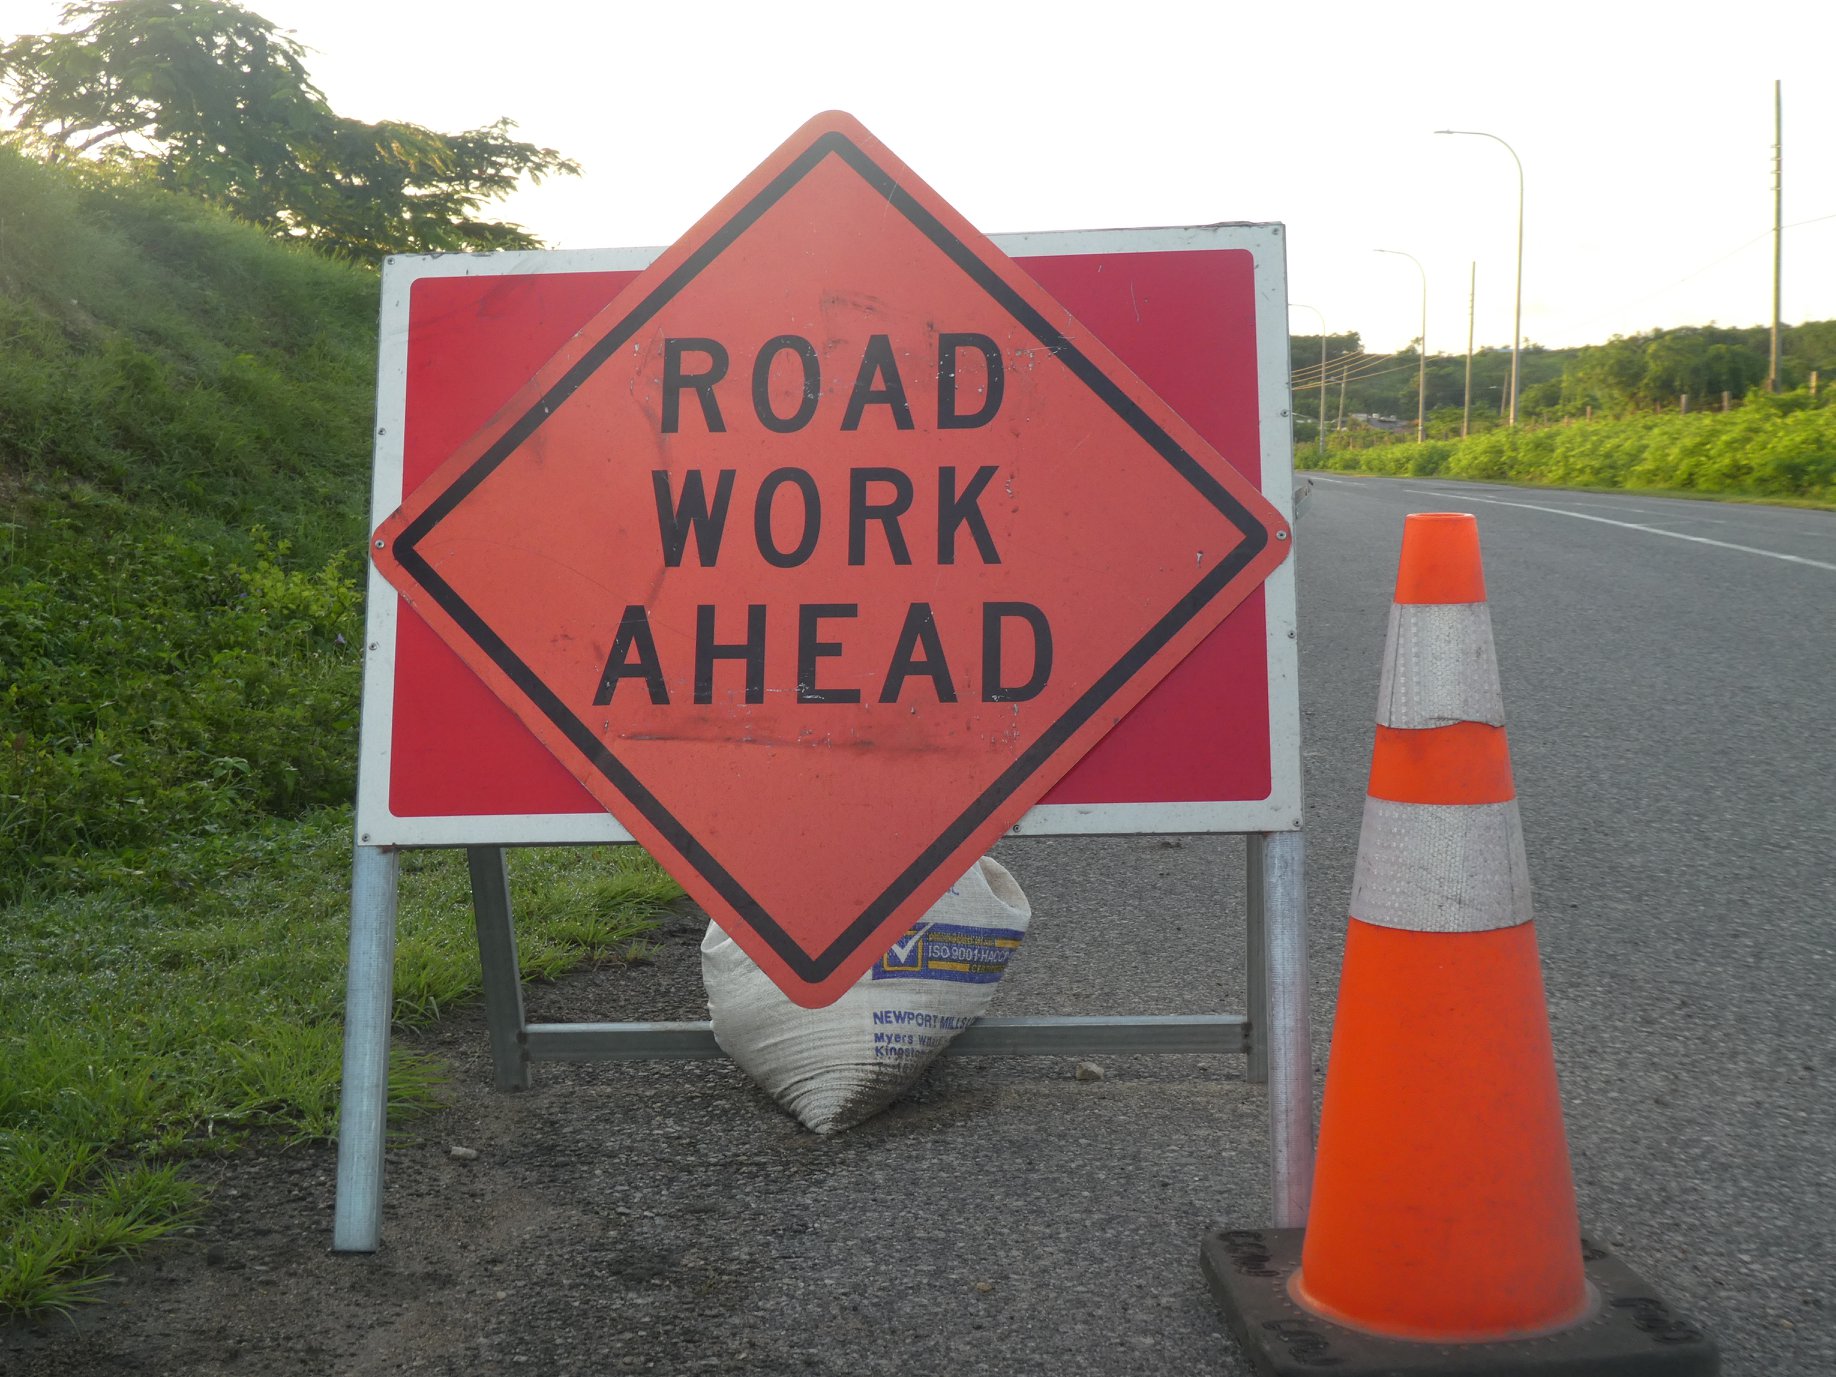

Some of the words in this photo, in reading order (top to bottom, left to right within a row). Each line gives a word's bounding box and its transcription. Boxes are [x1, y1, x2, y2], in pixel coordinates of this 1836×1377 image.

[661, 333, 1005, 434] ROAD
[652, 465, 1002, 569] WORK
[592, 601, 1054, 706] AHEAD
[873, 1010, 937, 1029] NEWPORT
[874, 1032, 913, 1045] Myers
